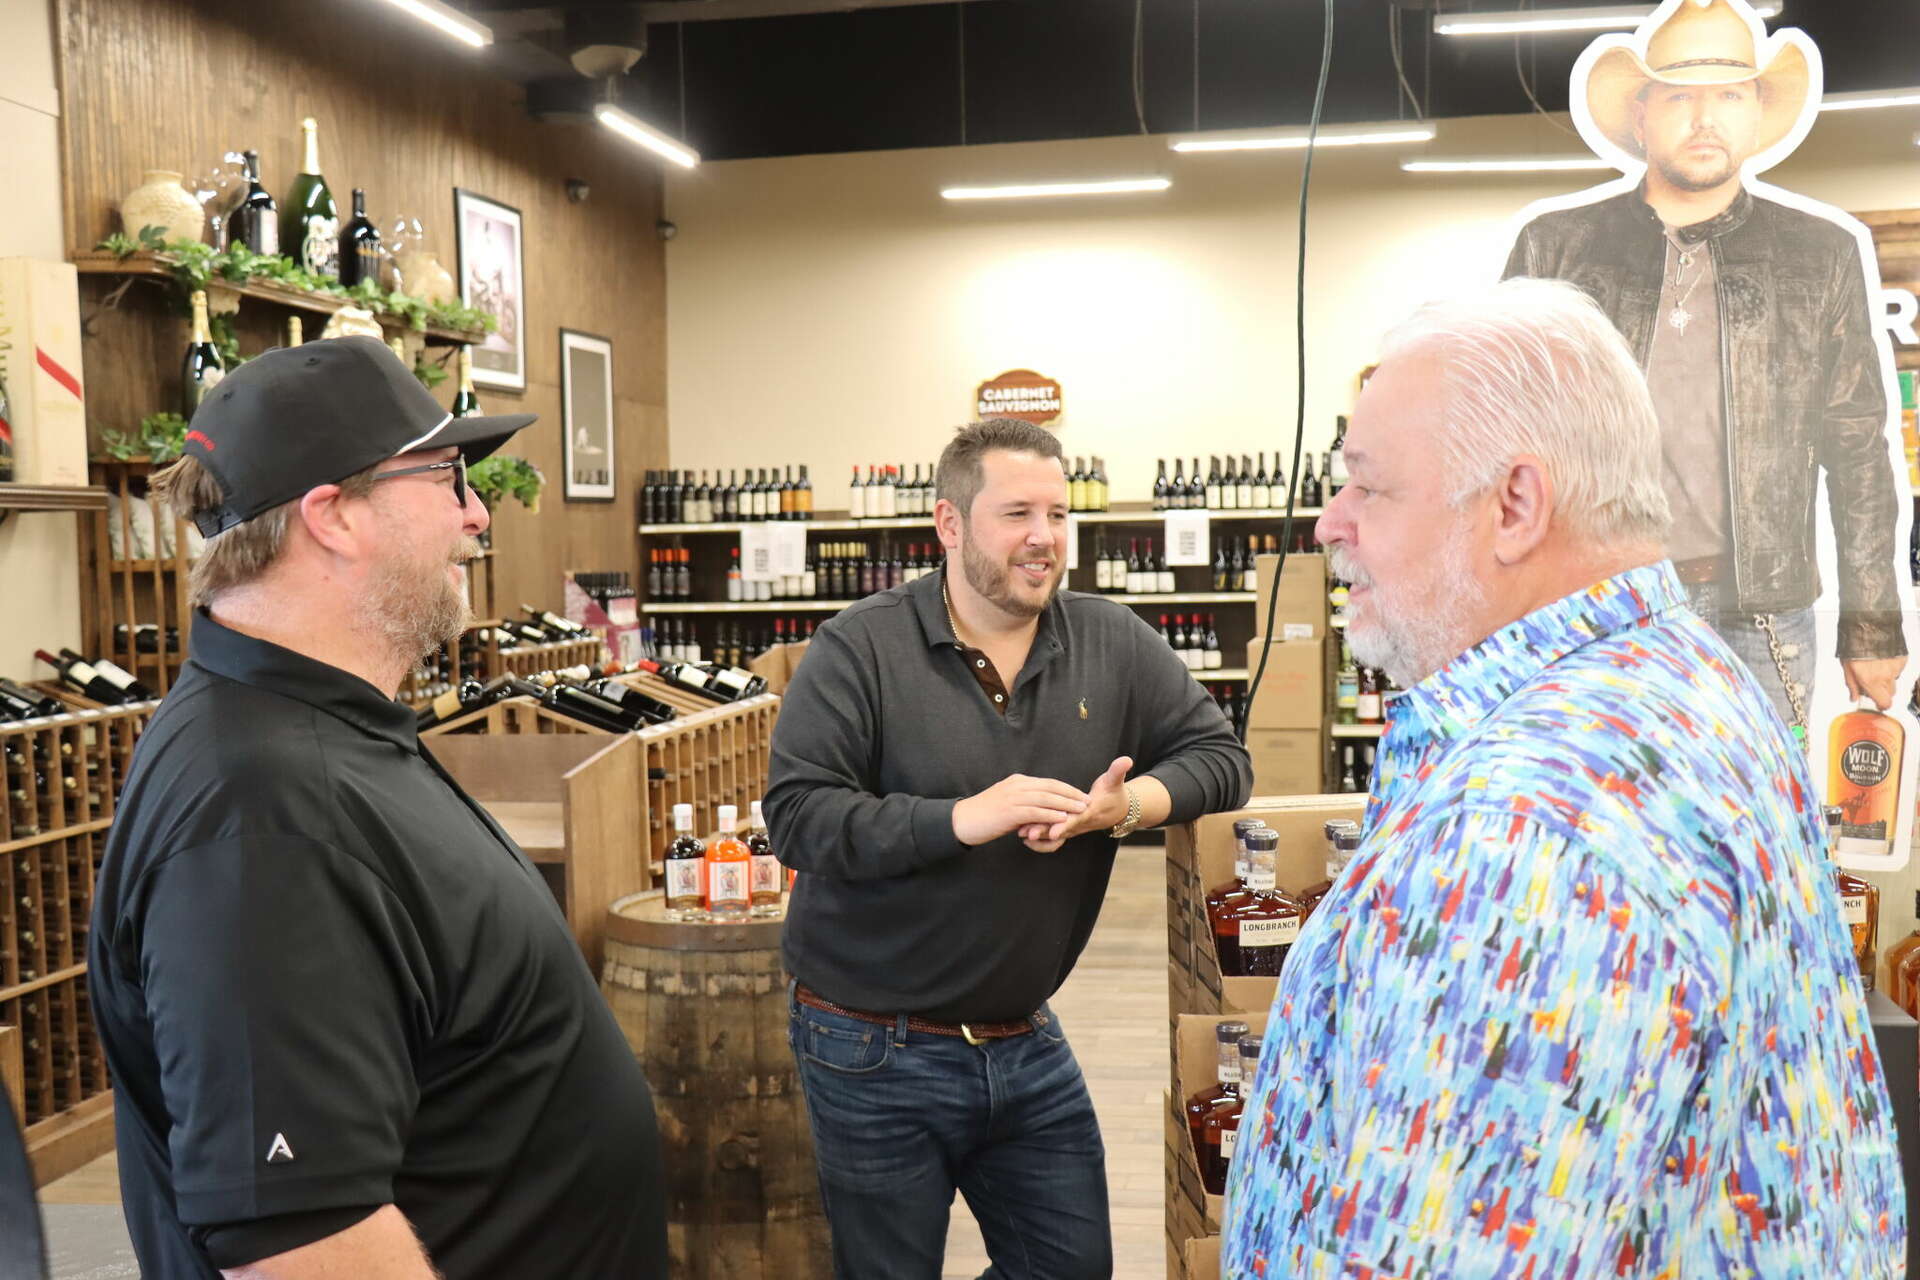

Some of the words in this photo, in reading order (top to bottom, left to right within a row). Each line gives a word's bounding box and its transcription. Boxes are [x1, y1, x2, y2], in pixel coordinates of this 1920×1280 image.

[984, 386, 1054, 400] CABERNET
[979, 399, 1059, 413] SAUVIGNON
[1848, 746, 1886, 767] WOLF
[1851, 763, 1879, 774] MOON
[1243, 920, 1297, 931] LONGBRANCH
